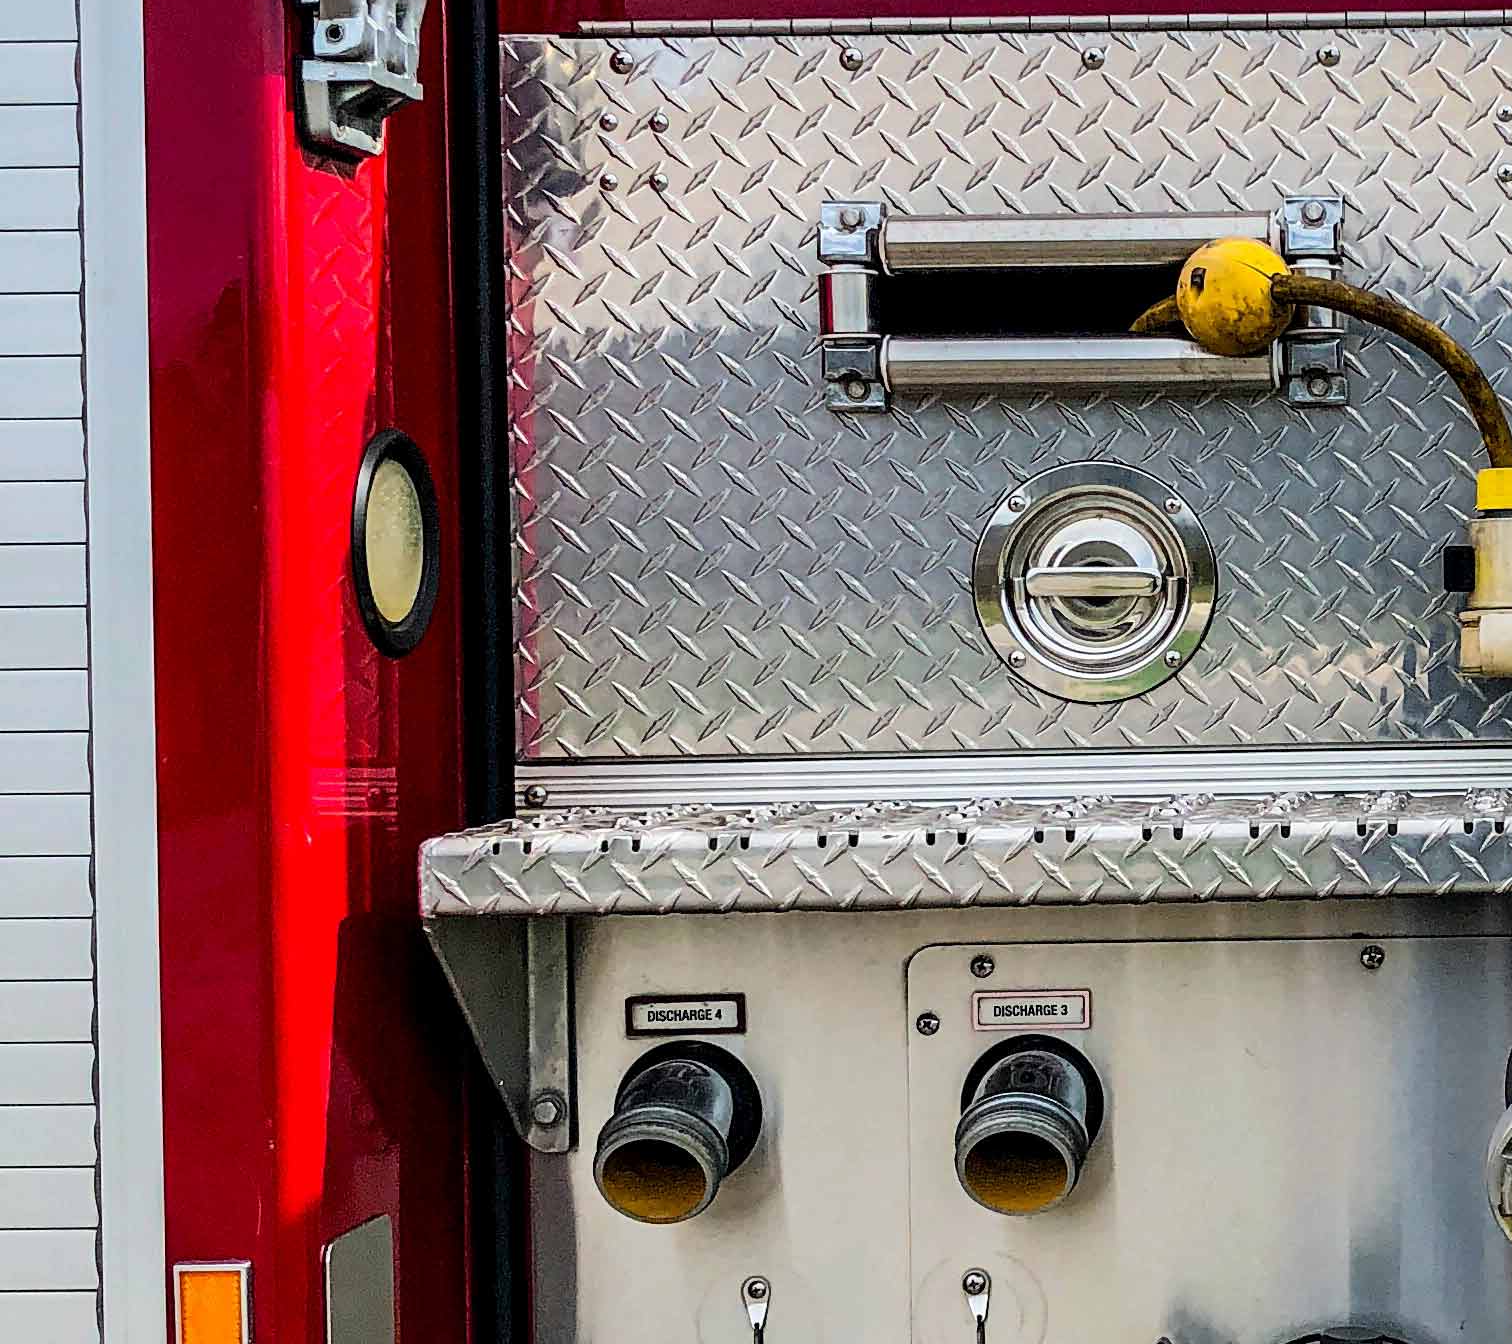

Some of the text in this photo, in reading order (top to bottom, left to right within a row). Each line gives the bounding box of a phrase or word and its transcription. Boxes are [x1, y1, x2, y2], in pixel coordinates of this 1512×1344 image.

[647, 1008, 722, 1022] DISCHARGE 4
[993, 1004, 1068, 1017] DISCHARGE 3
